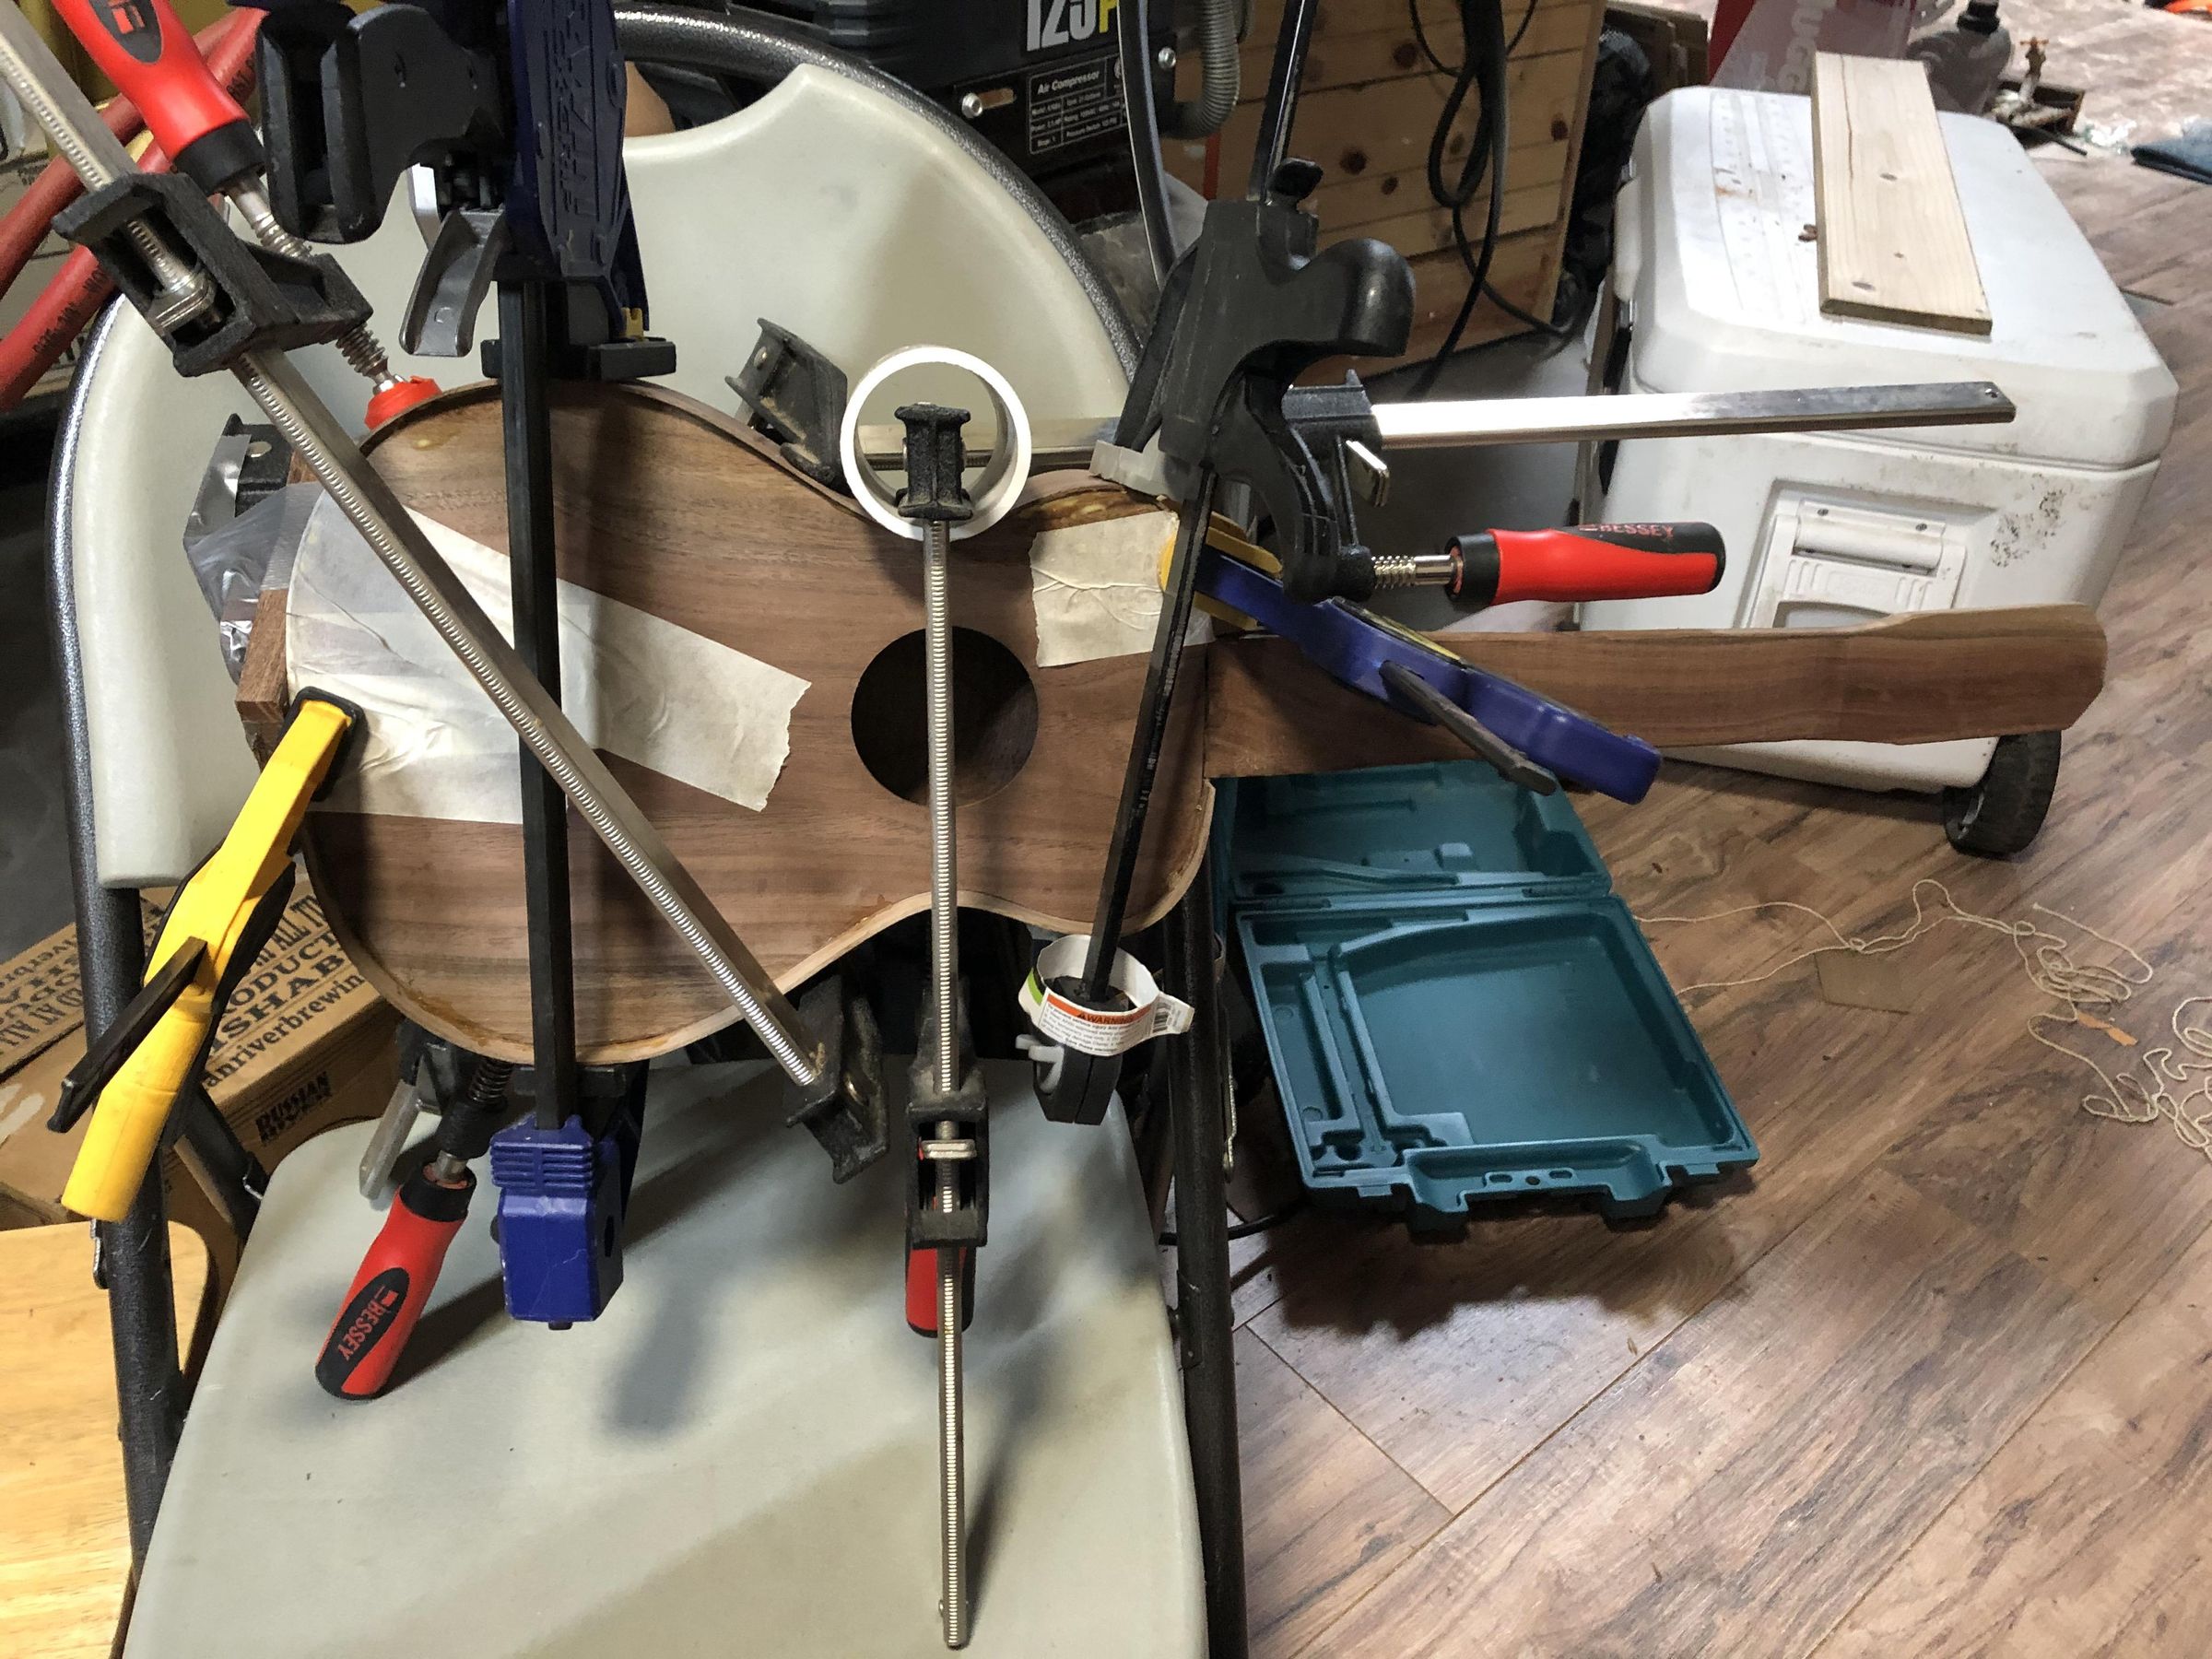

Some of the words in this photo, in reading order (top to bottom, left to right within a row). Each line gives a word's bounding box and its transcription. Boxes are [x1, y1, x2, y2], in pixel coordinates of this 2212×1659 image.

[1037, 83, 1051, 95] Air
[1051, 71, 1100, 91] Compressor
[337, 1298, 388, 1361] BESSEY
